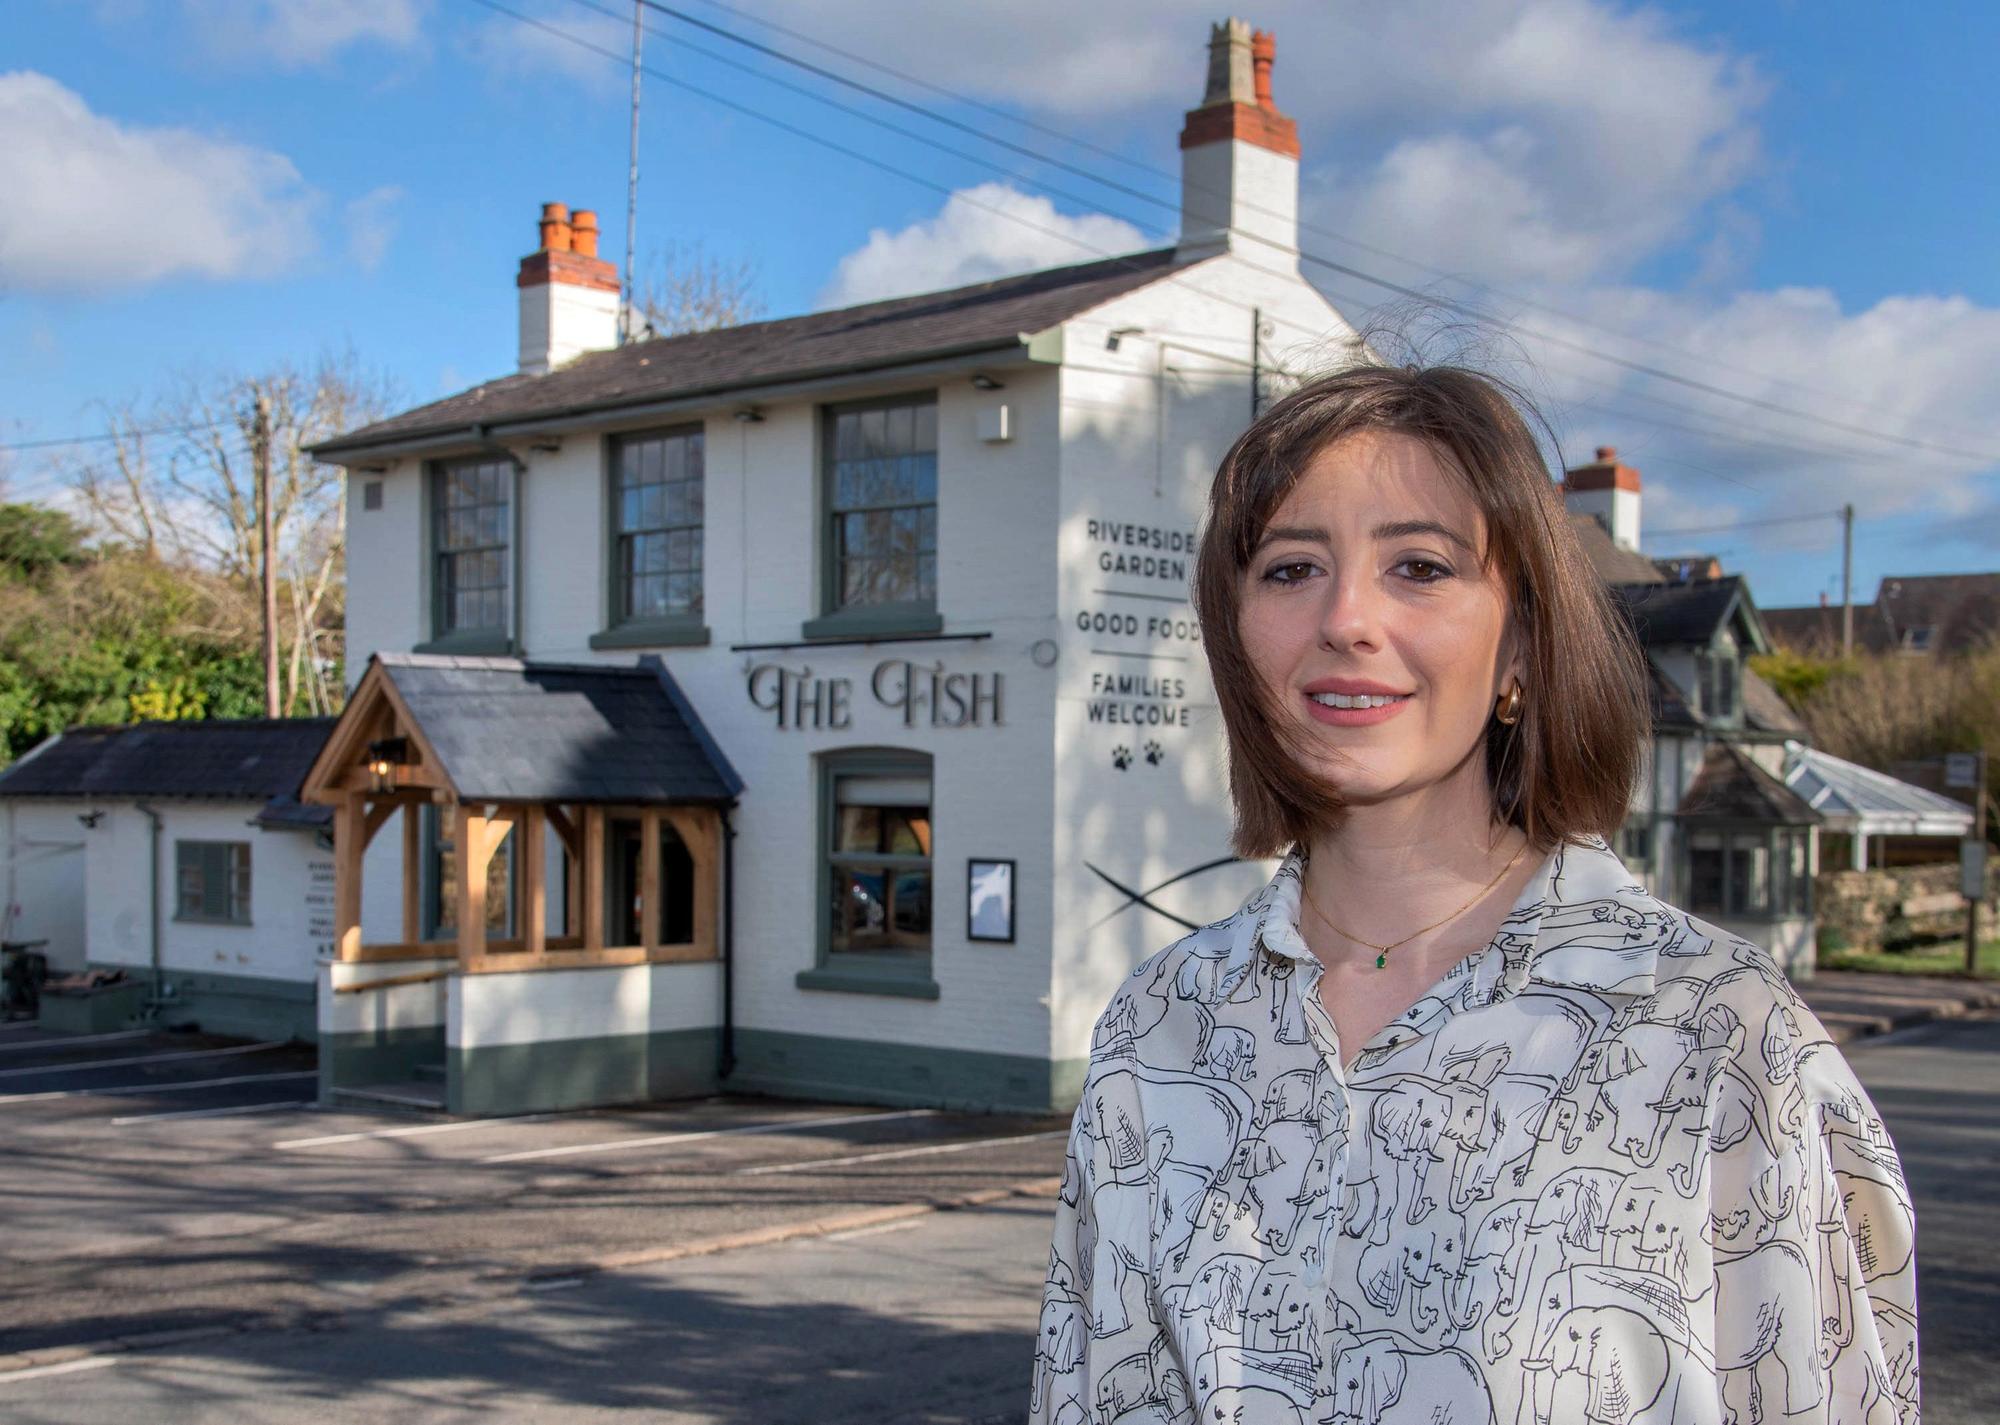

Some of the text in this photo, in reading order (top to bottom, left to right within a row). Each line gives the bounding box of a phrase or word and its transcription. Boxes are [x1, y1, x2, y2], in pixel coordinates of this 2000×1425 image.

[1088, 520, 1195, 553] RIVERSIDE
[1099, 552, 1185, 580] GARDEN
[1077, 611, 1200, 641] GOOD FOOD
[744, 658, 1005, 729] THE FISH
[1092, 673, 1185, 698] FAMILIES
[1087, 703, 1190, 727] WELCOME
